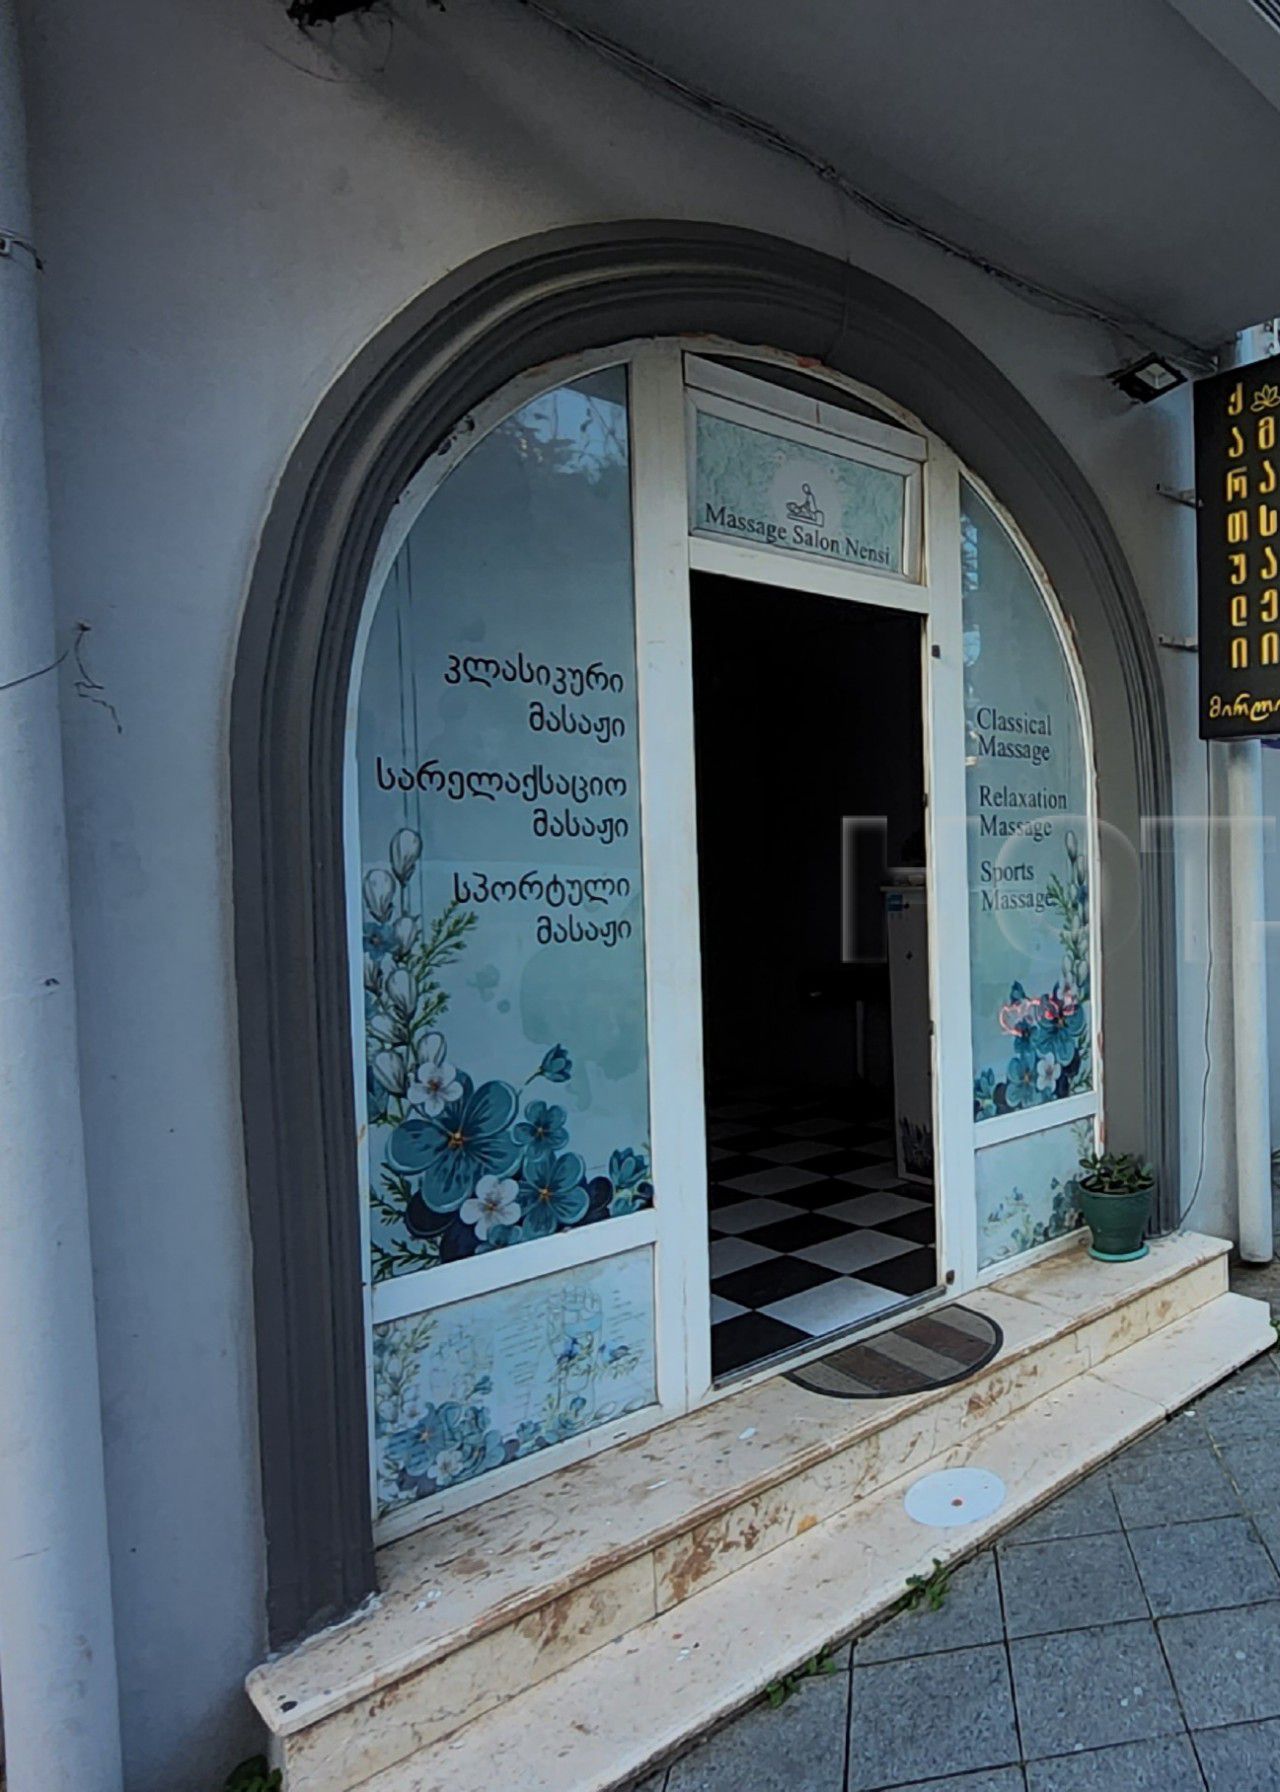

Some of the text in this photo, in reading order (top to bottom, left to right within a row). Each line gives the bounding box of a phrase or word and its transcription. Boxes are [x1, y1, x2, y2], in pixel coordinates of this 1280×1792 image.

[705, 502, 890, 565] Massage Salon Nensi
[1226, 382, 1249, 667] ქართული
[1258, 416, 1280, 665] მასაჟი
[444, 652, 624, 696] კლასიკური
[529, 701, 625, 743] მასაჟი
[976, 707, 1052, 736] Classical
[977, 735, 1051, 766] Massage
[376, 757, 628, 803] სარელაქსაციო
[979, 785, 1068, 810] Relaxation
[533, 808, 629, 844] მასაჟი
[980, 814, 1053, 842] Massage
[453, 870, 630, 906] სპორტული
[981, 860, 1034, 888] Sports
[981, 889, 1056, 913] Massage
[537, 913, 632, 947] მასაჟი
